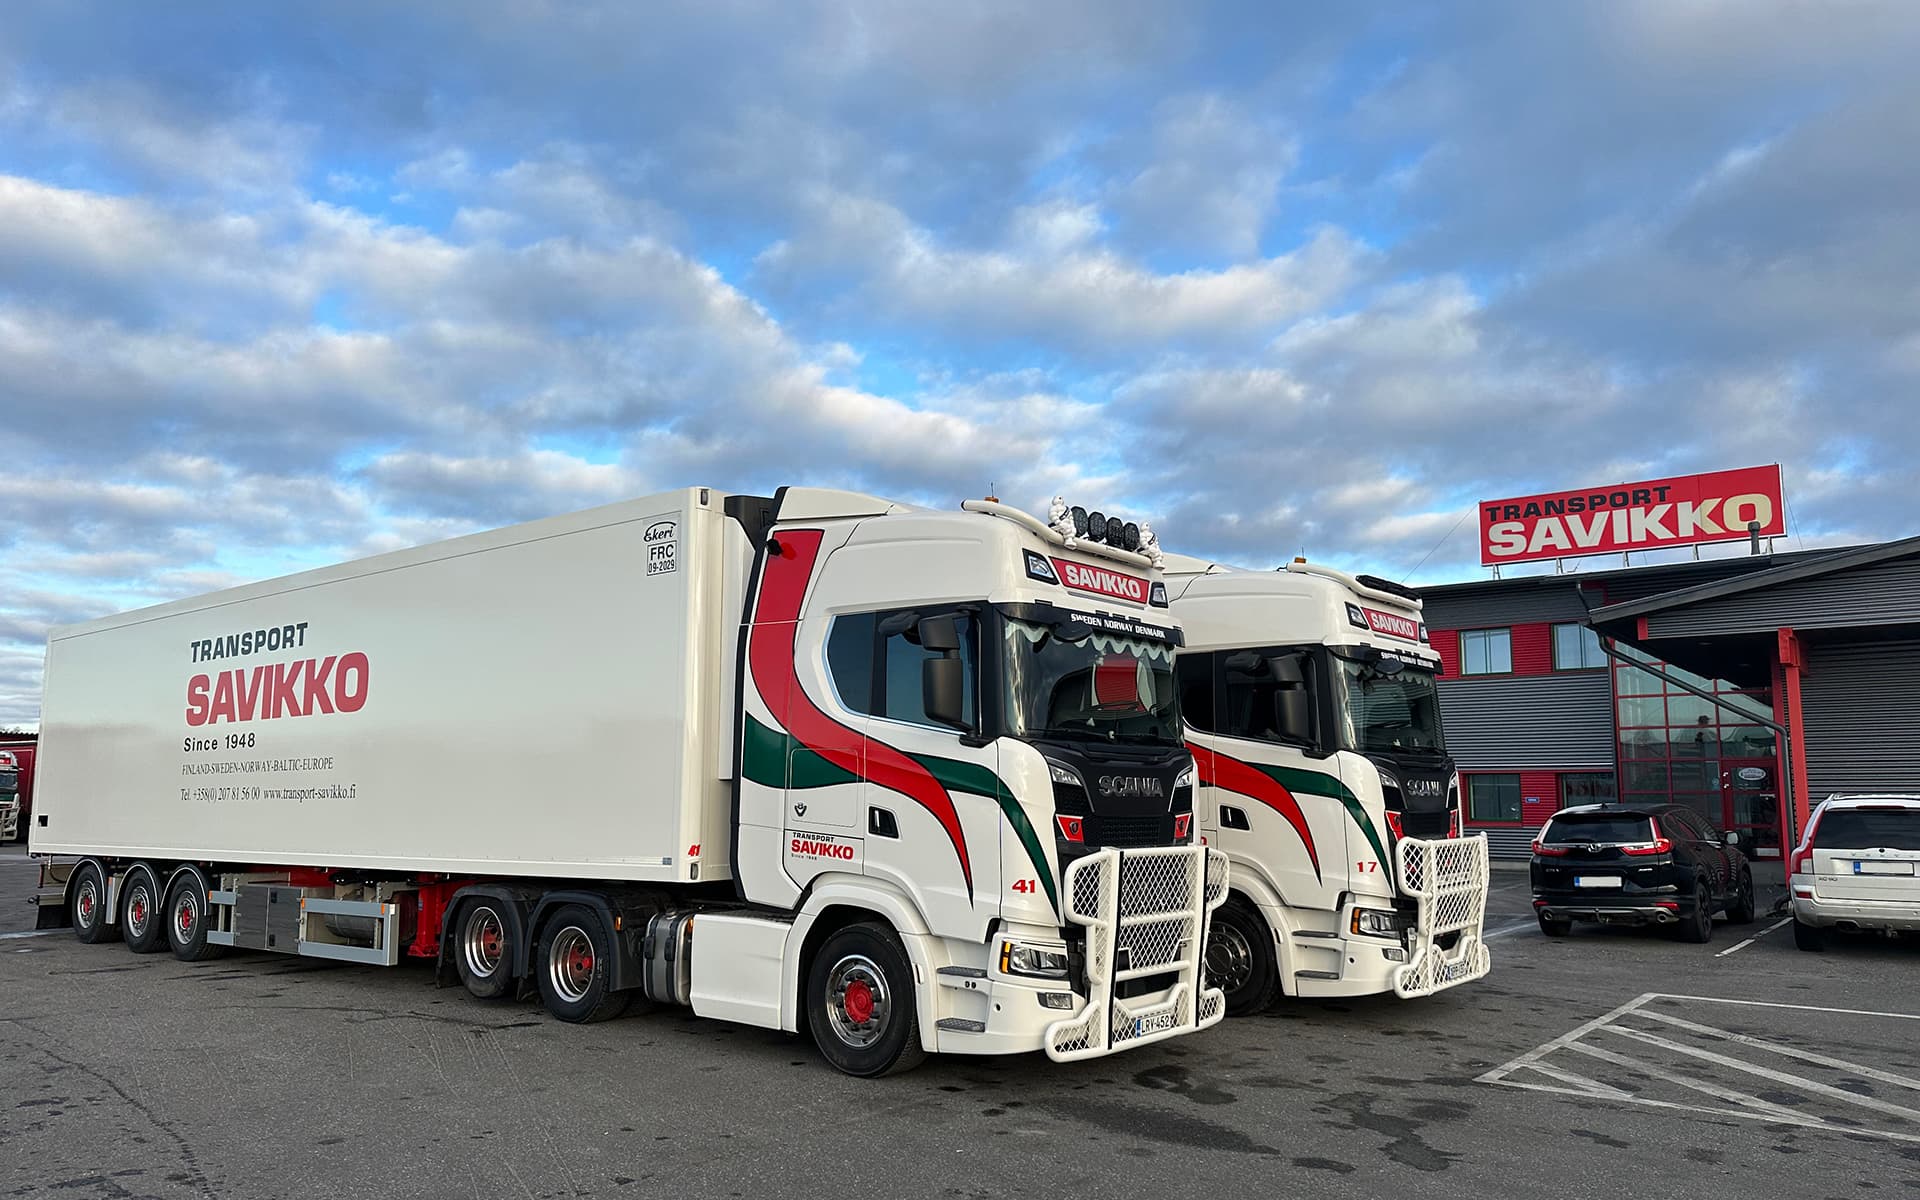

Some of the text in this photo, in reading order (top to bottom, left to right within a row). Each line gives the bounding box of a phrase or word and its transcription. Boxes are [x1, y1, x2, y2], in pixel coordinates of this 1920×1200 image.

[1485, 486, 1671, 521] TRANSPORT
[643, 522, 676, 542] Ekeri
[1488, 493, 1772, 557] SAVIKKO
[650, 544, 674, 561] FRC
[648, 559, 675, 573] 09-2029
[1065, 565, 1141, 598] SAVIKKO
[1071, 613, 1166, 639] SWEDEN NORWAY DENMARK
[1370, 612, 1415, 637] SAVIKKO
[191, 622, 308, 663] TRANSPORT
[186, 652, 369, 726] SAVIKKO
[184, 733, 255, 752] Since 1948
[182, 757, 334, 775] FINLAND-SWEDEN-NORWAY-BALTIC-EUROPE
[180, 784, 357, 804] Tel. +358(0) 207 81 56 00 www.transport-savikko.fi
[1098, 775, 1164, 798] SCANIA
[1407, 779, 1443, 797] SCANIA
[793, 832, 834, 842] TRANSPORT
[688, 844, 701, 856] 41
[791, 839, 854, 860] SAVIKKO
[1356, 861, 1378, 873] 17
[1011, 879, 1036, 894] 41
[1141, 1014, 1171, 1033] LRV-452
